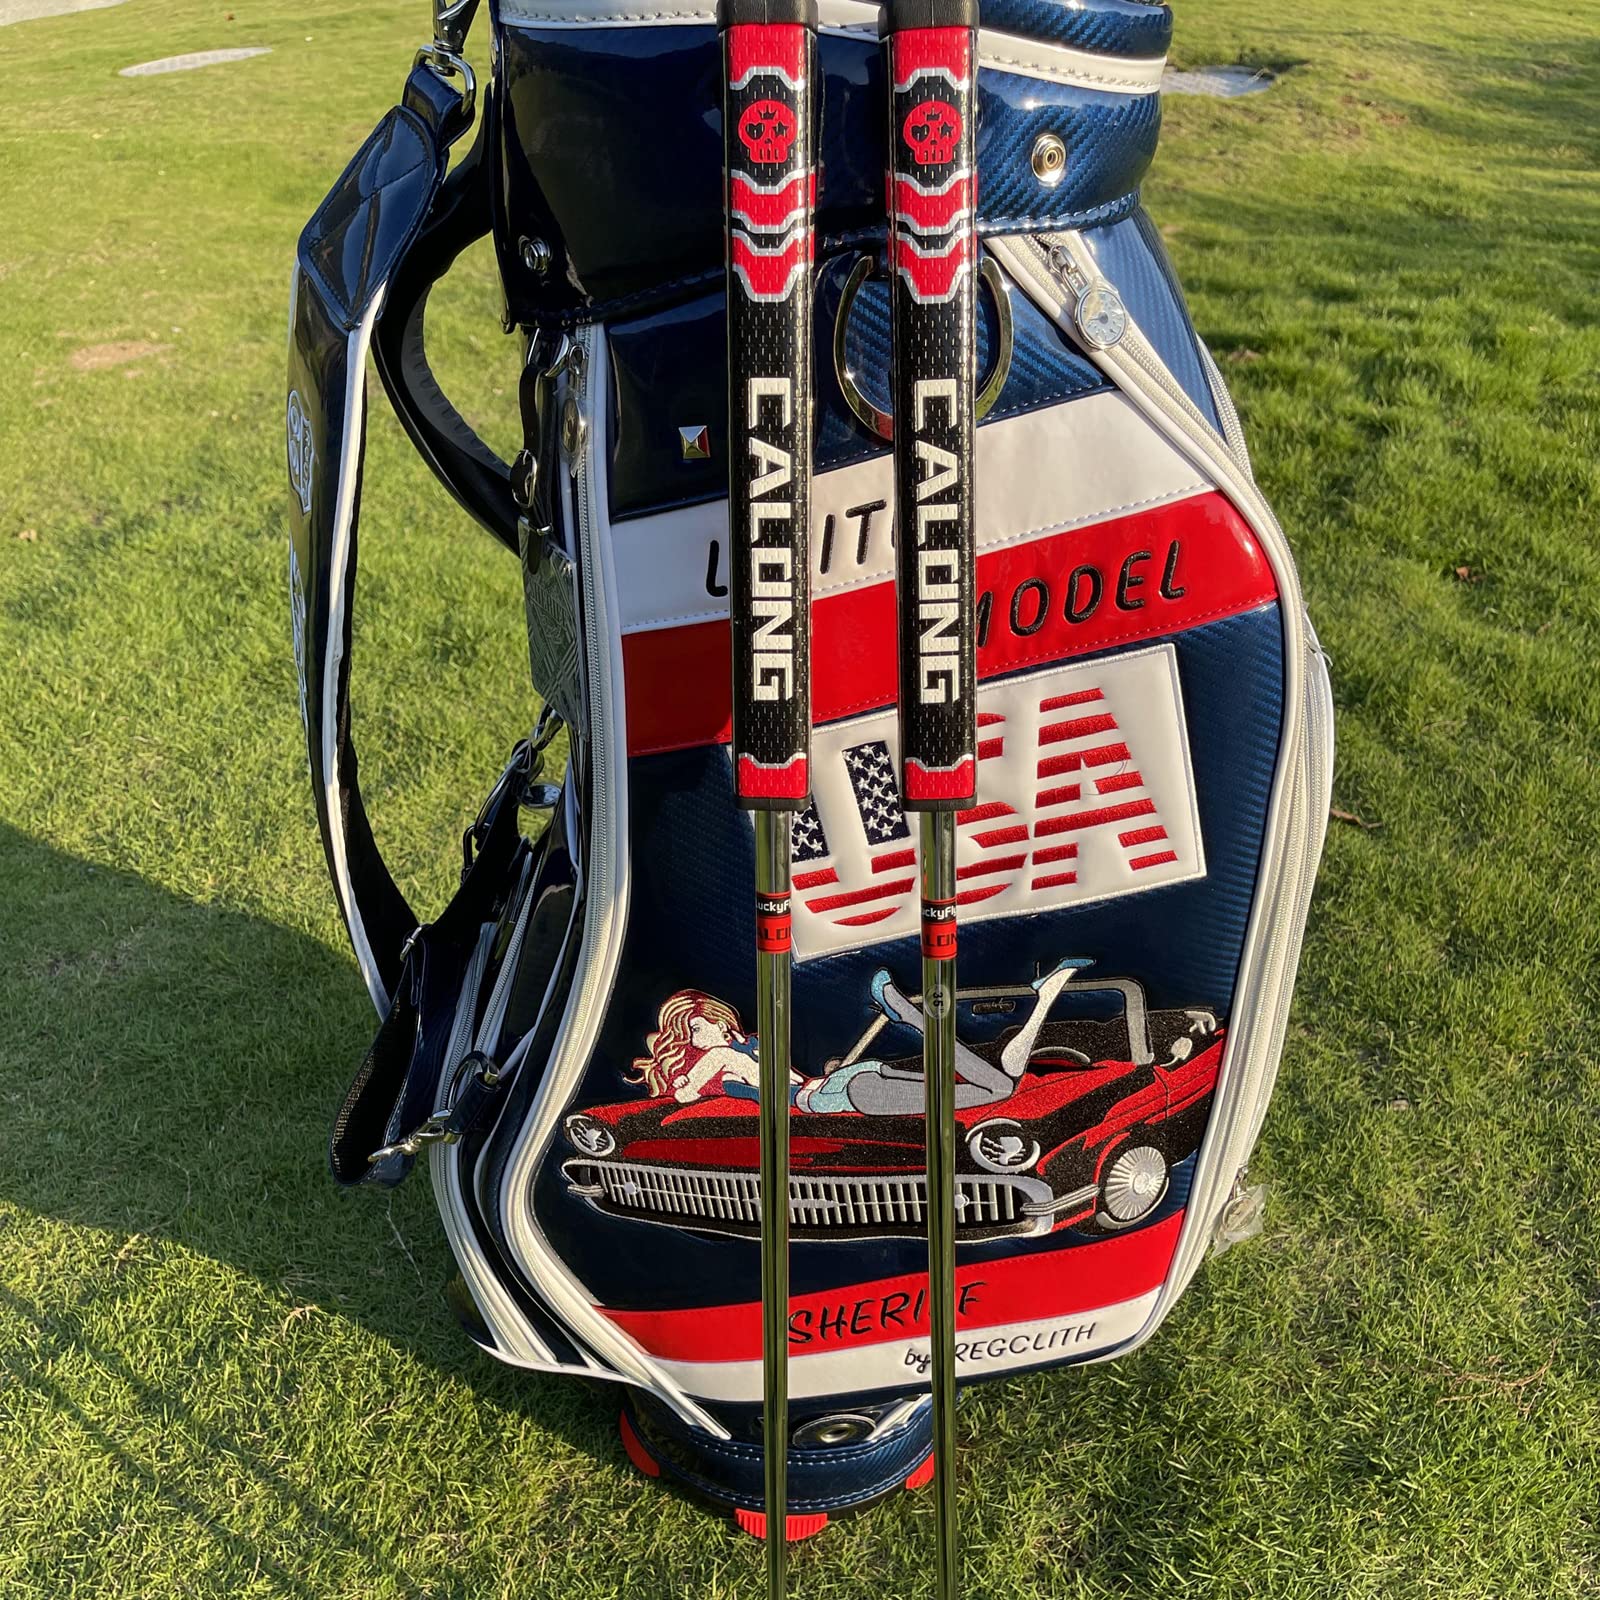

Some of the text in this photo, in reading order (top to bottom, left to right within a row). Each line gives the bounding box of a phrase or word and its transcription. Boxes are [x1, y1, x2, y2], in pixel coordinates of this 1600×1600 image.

[749, 377, 793, 701] CALONG
[914, 378, 960, 704] CALONG
[788, 1281, 987, 1344] SHERIF
[904, 1347, 932, 1374] by
